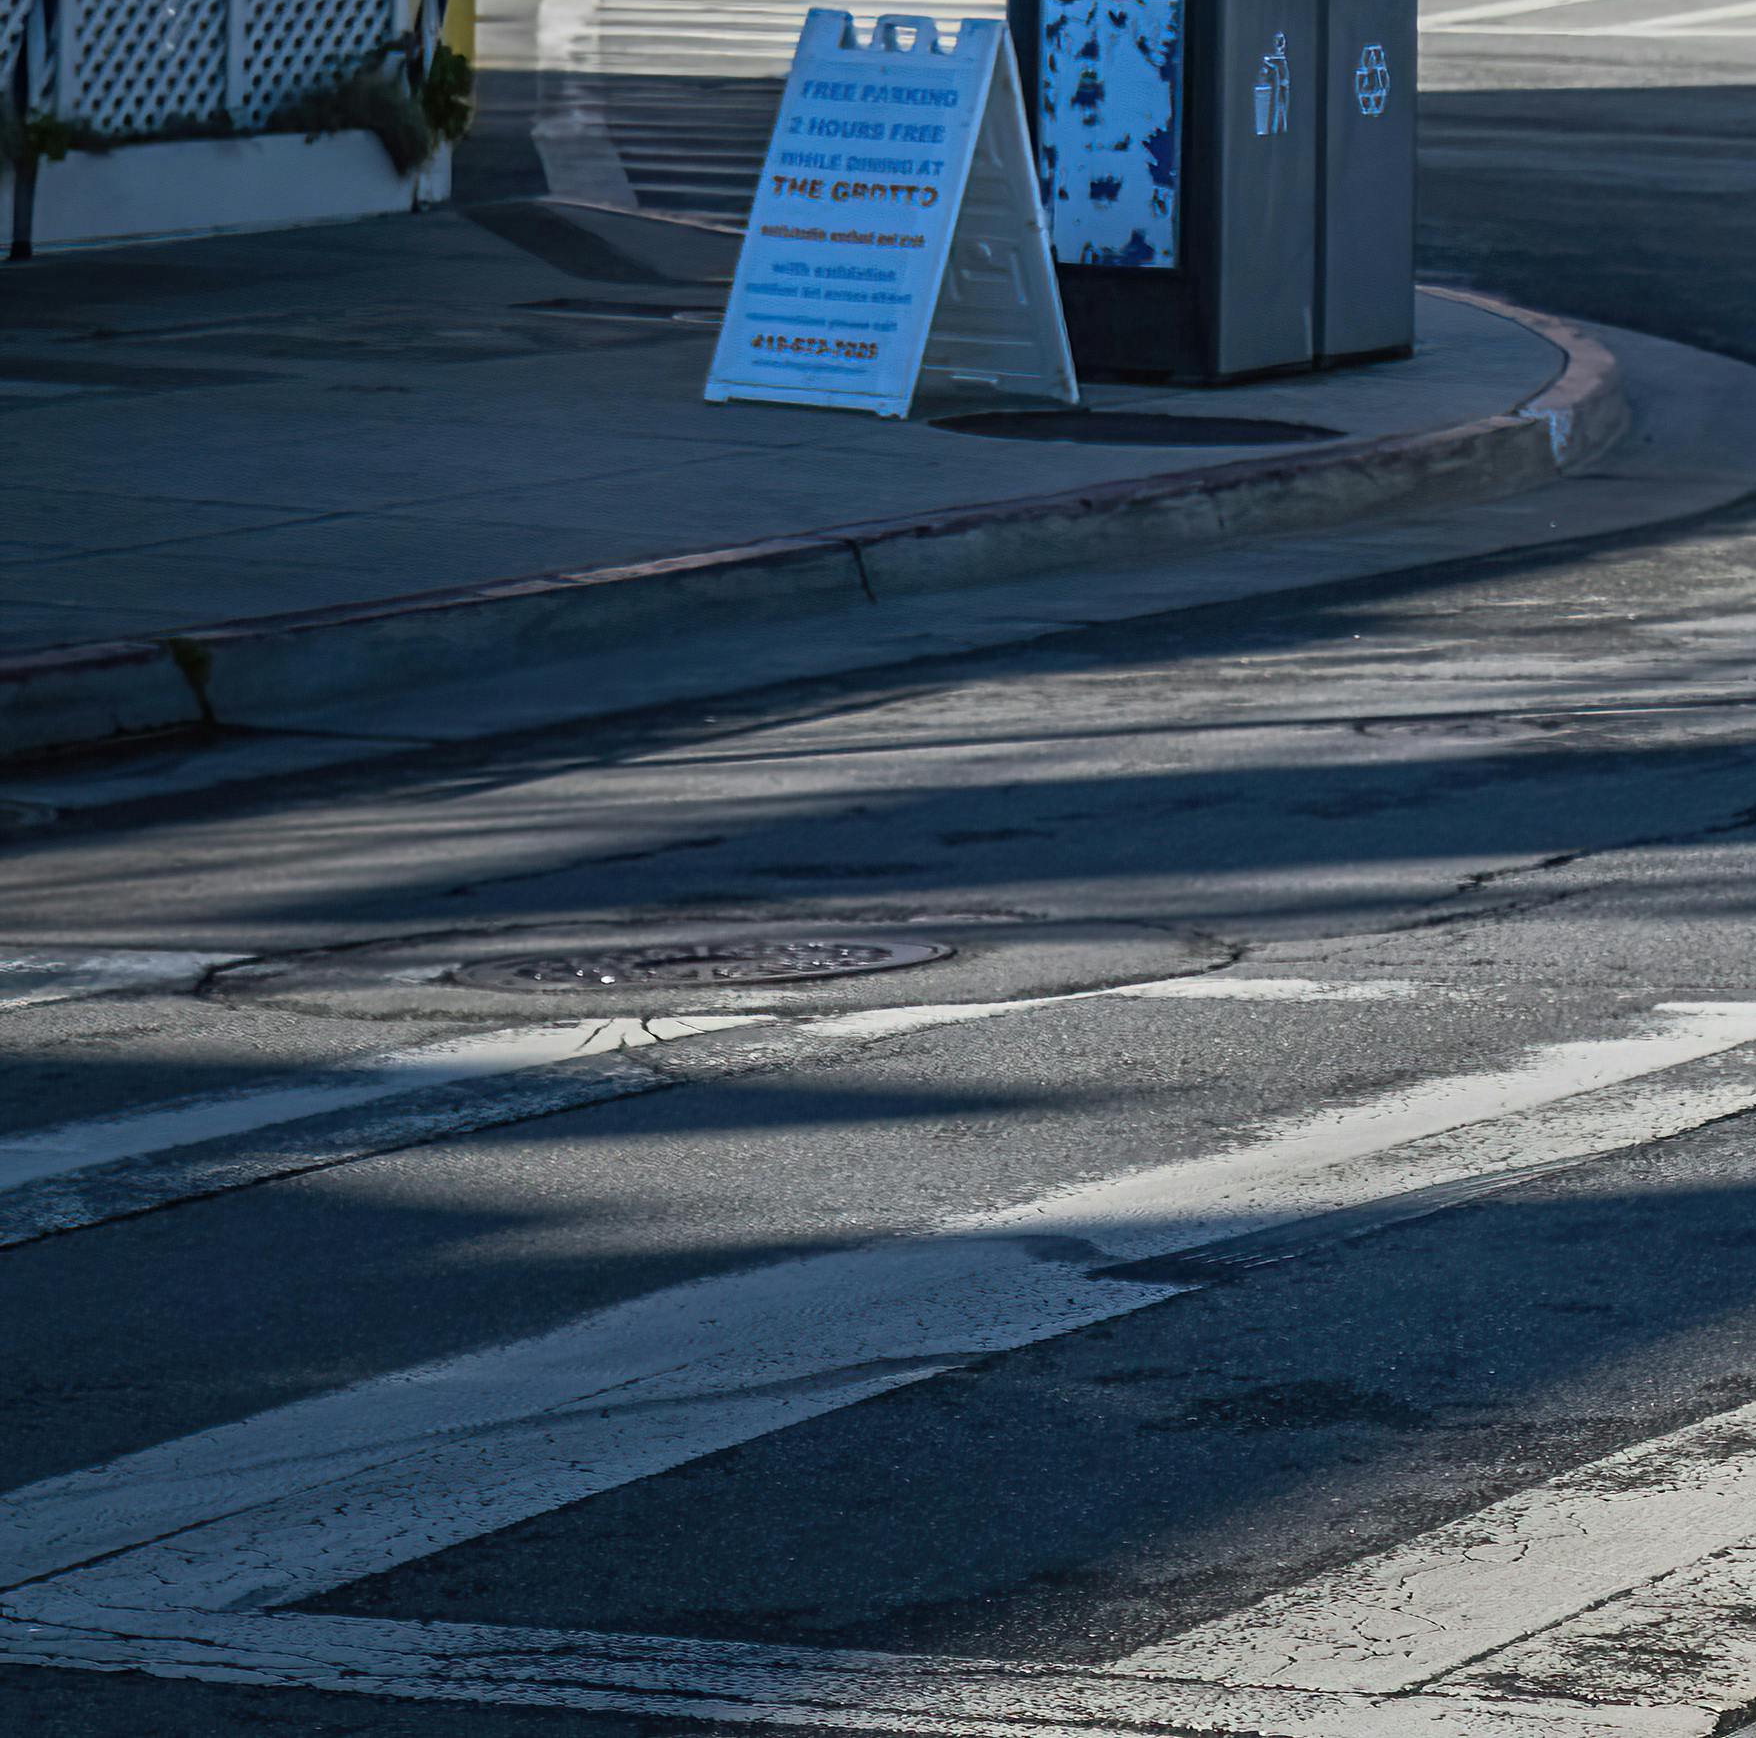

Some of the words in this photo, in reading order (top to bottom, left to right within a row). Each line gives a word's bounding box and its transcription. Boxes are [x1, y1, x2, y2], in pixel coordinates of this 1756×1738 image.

[801, 80, 857, 102] FREE
[888, 123, 946, 144] FREE
[771, 175, 825, 200] THE
[830, 180, 940, 208] GROTTO
